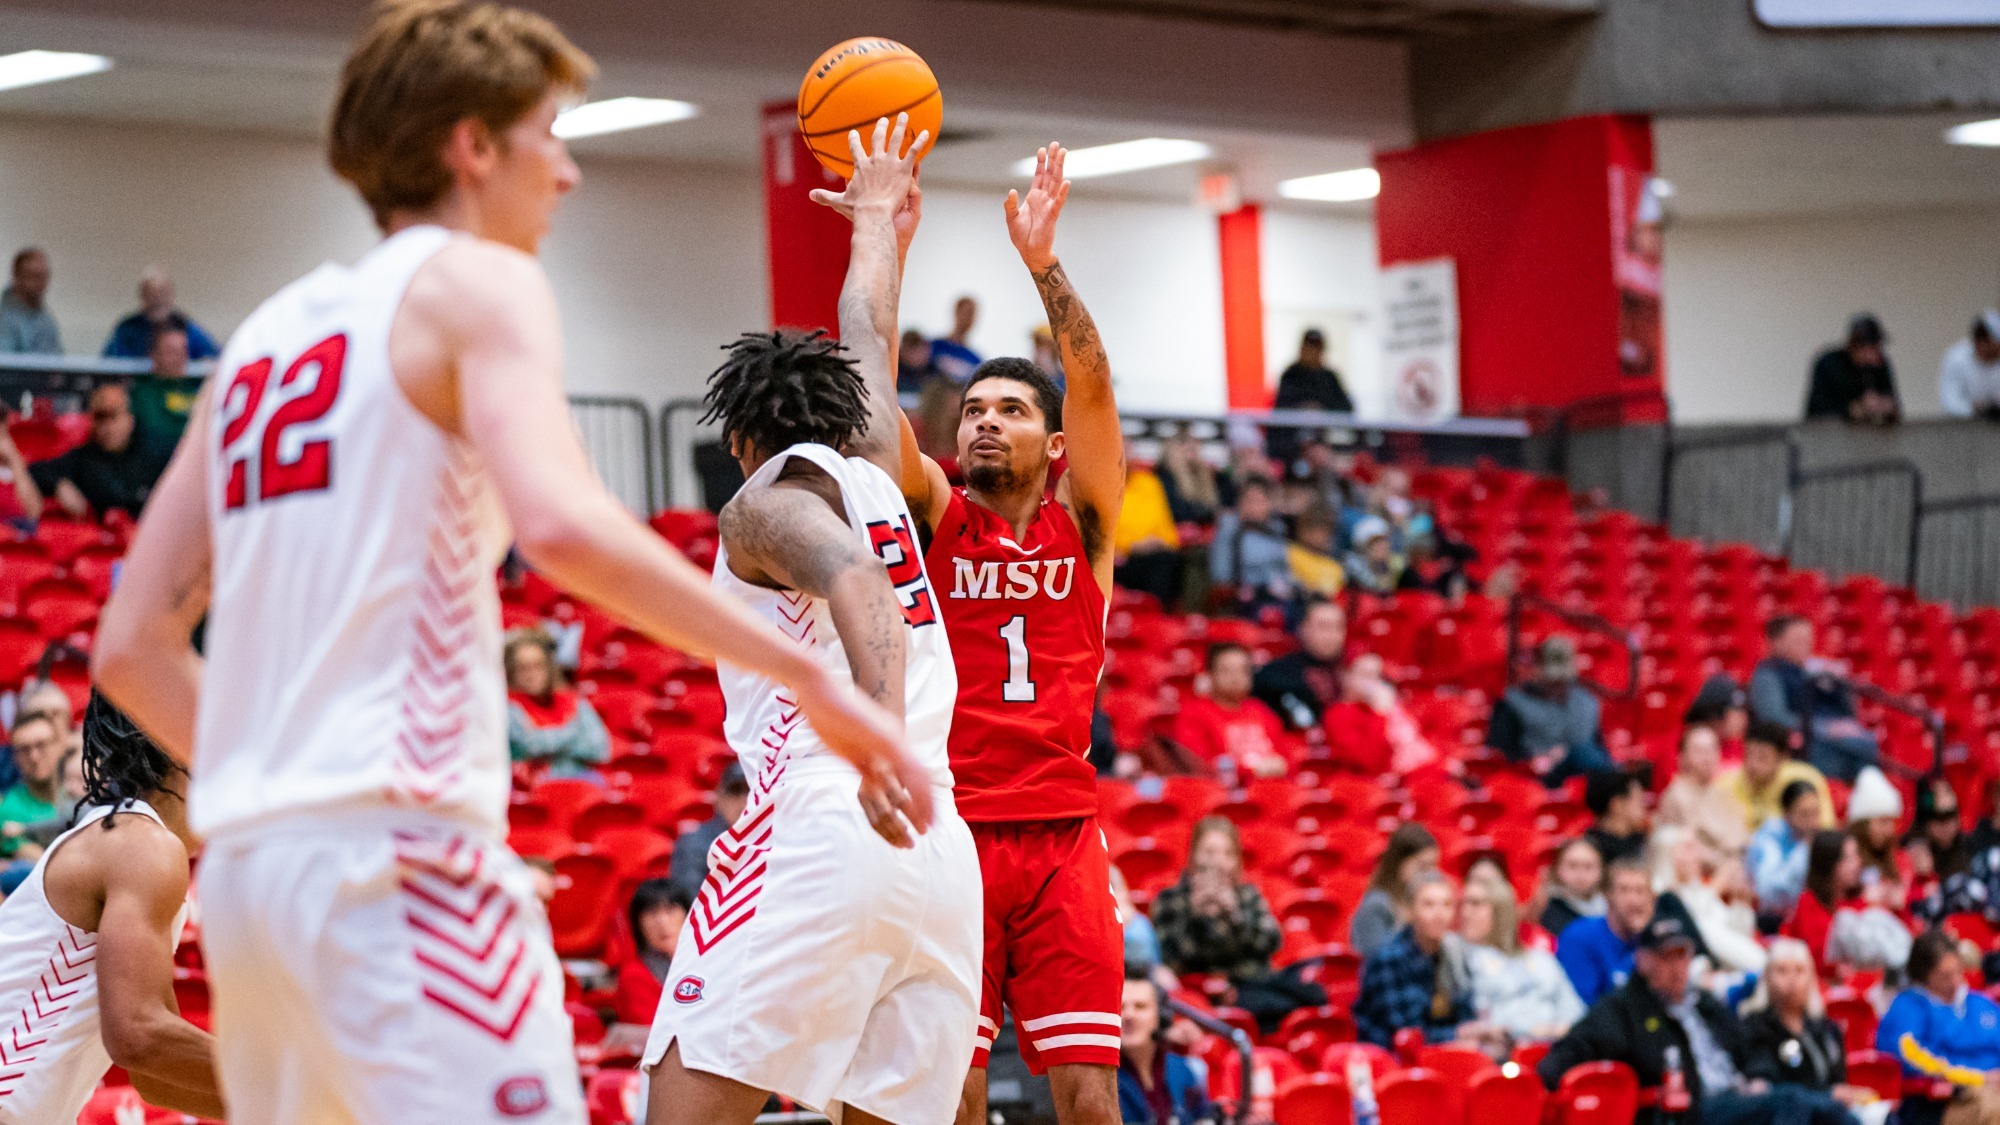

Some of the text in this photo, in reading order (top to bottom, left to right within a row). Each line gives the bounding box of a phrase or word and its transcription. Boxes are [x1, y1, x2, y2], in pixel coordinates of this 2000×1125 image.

[222, 331, 348, 510] 22
[949, 556, 1076, 601] MSU
[998, 614, 1036, 703] 1
